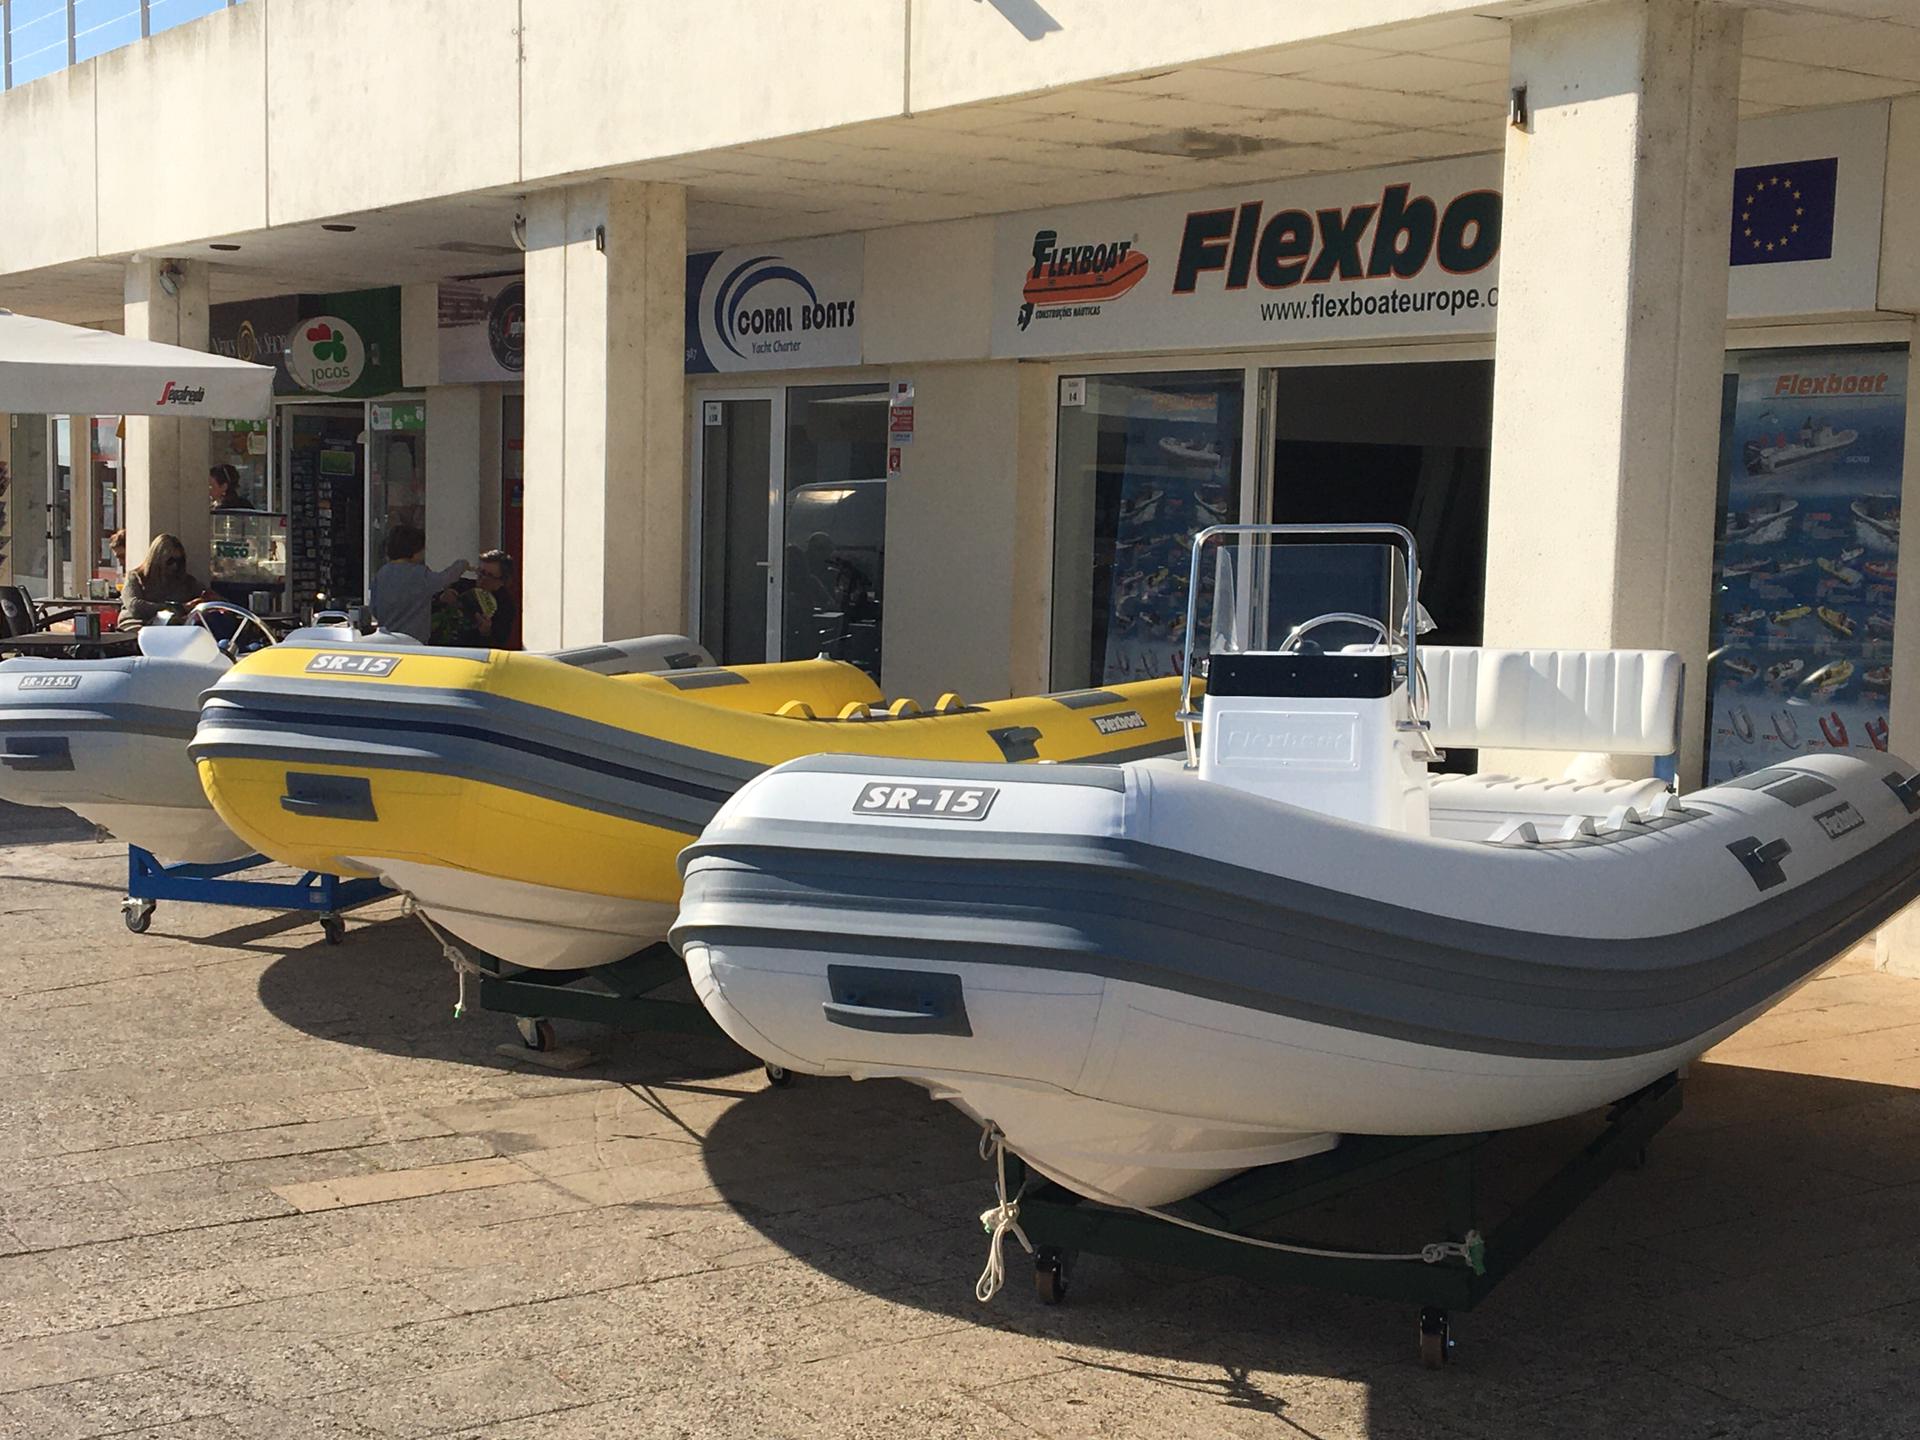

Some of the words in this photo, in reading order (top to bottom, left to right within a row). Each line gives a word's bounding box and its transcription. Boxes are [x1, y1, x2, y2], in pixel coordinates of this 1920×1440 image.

[1172, 182, 1503, 295] Flexbo
[1032, 230, 1132, 279] FLEXBOAT
[737, 306, 793, 335] CORAL
[801, 300, 855, 330] BOATS
[751, 341, 772, 354] Yacht
[772, 339, 802, 353] Charter
[311, 366, 351, 385] JOGOS
[1774, 372, 1889, 396] Flexboat
[312, 655, 391, 672] SR-15
[54, 676, 76, 687] SLX
[862, 786, 984, 813] SR-15
